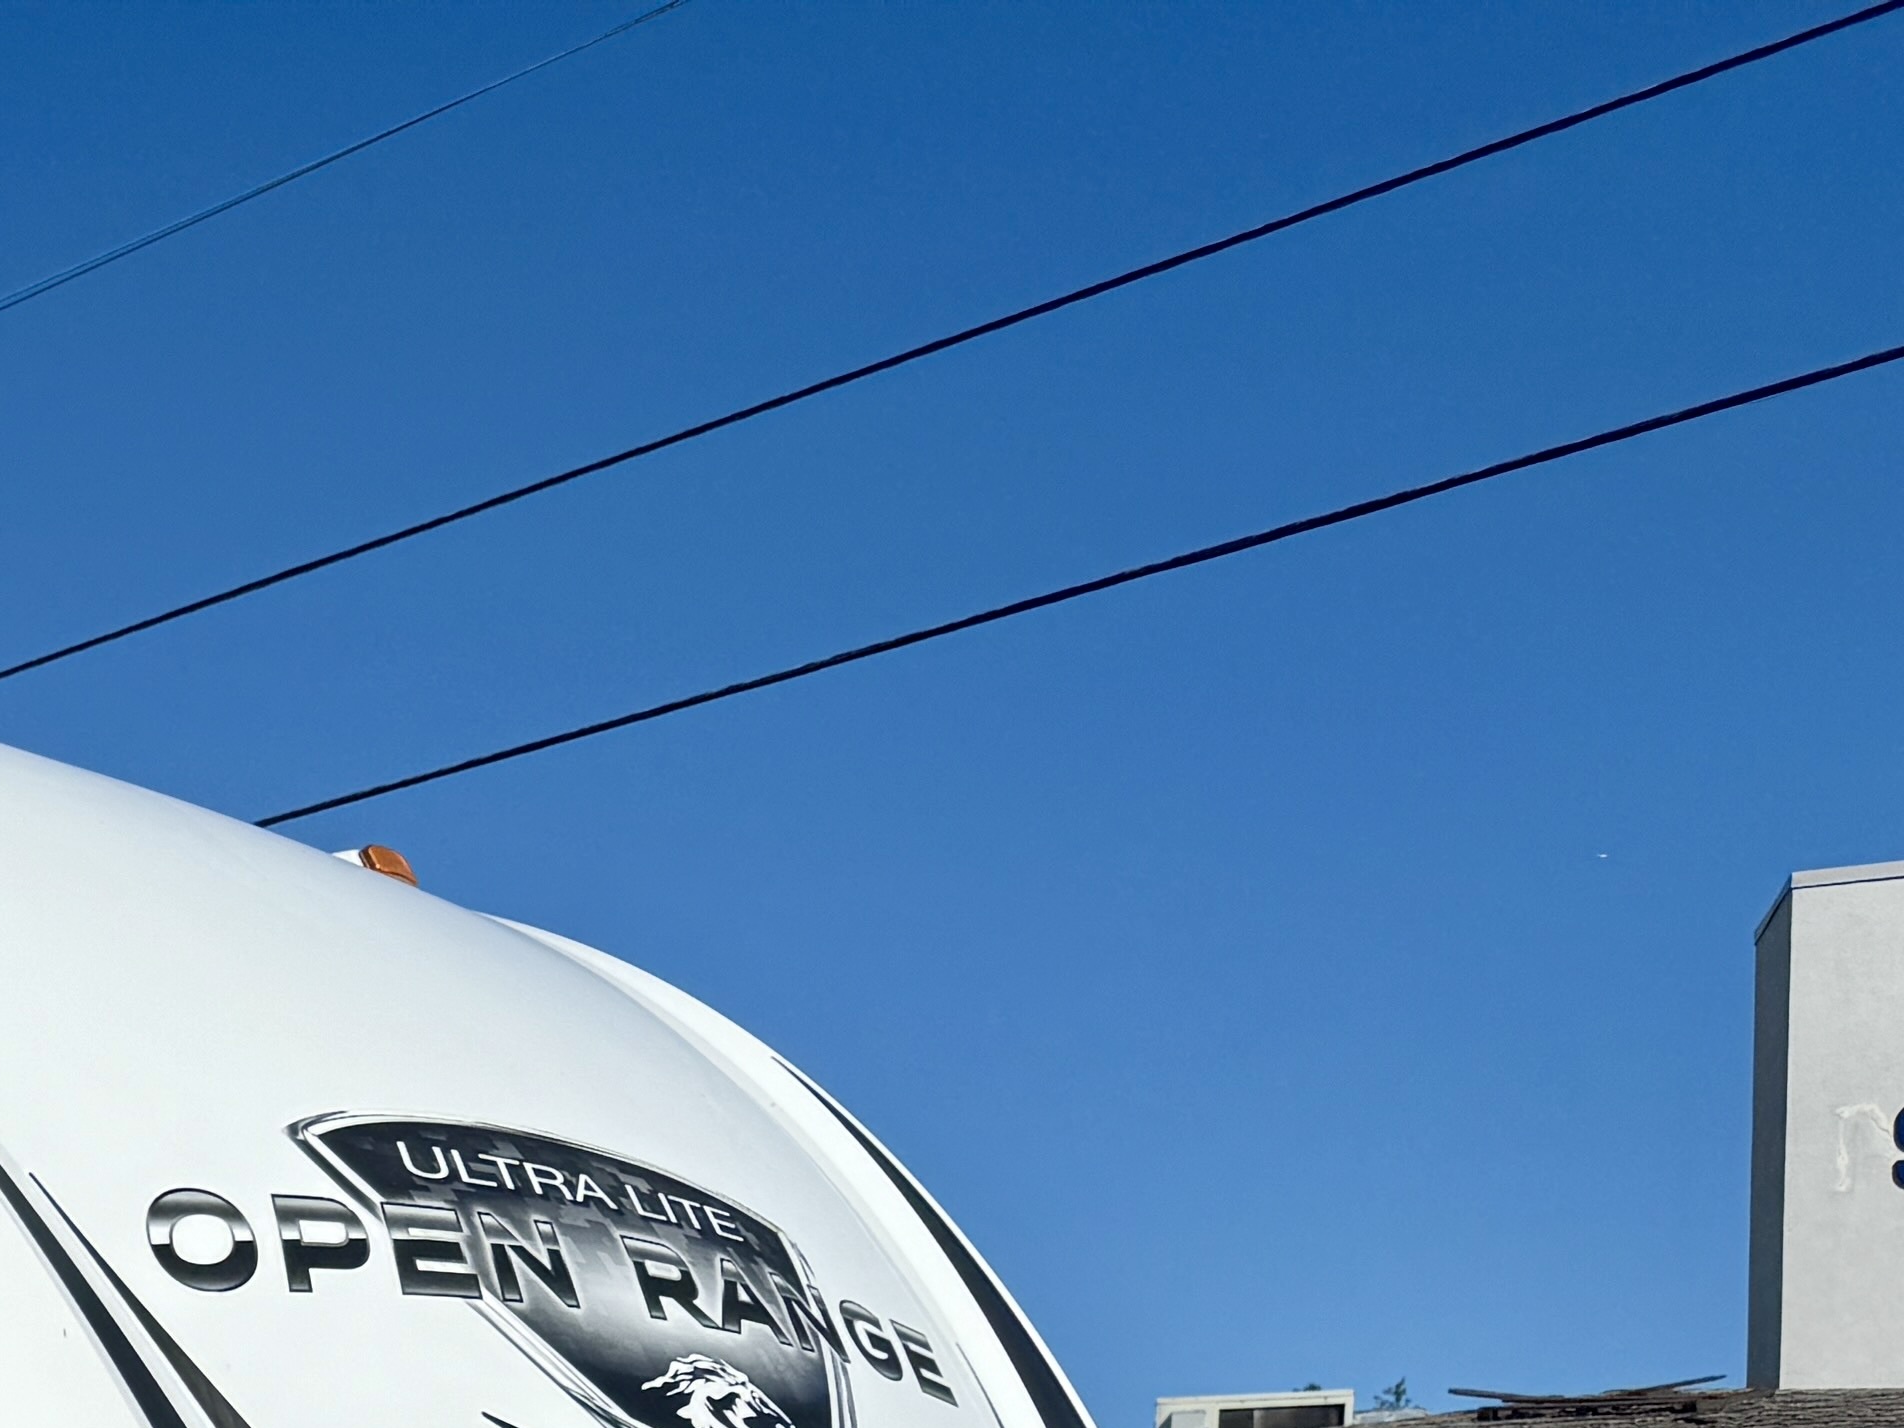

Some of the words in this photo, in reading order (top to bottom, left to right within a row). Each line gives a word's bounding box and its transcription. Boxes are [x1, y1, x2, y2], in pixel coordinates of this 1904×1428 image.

[395, 1138, 616, 1211] ULTRA
[625, 1184, 743, 1243] LITE
[145, 1187, 582, 1309] OPEN
[620, 1235, 960, 1408] RANGE
